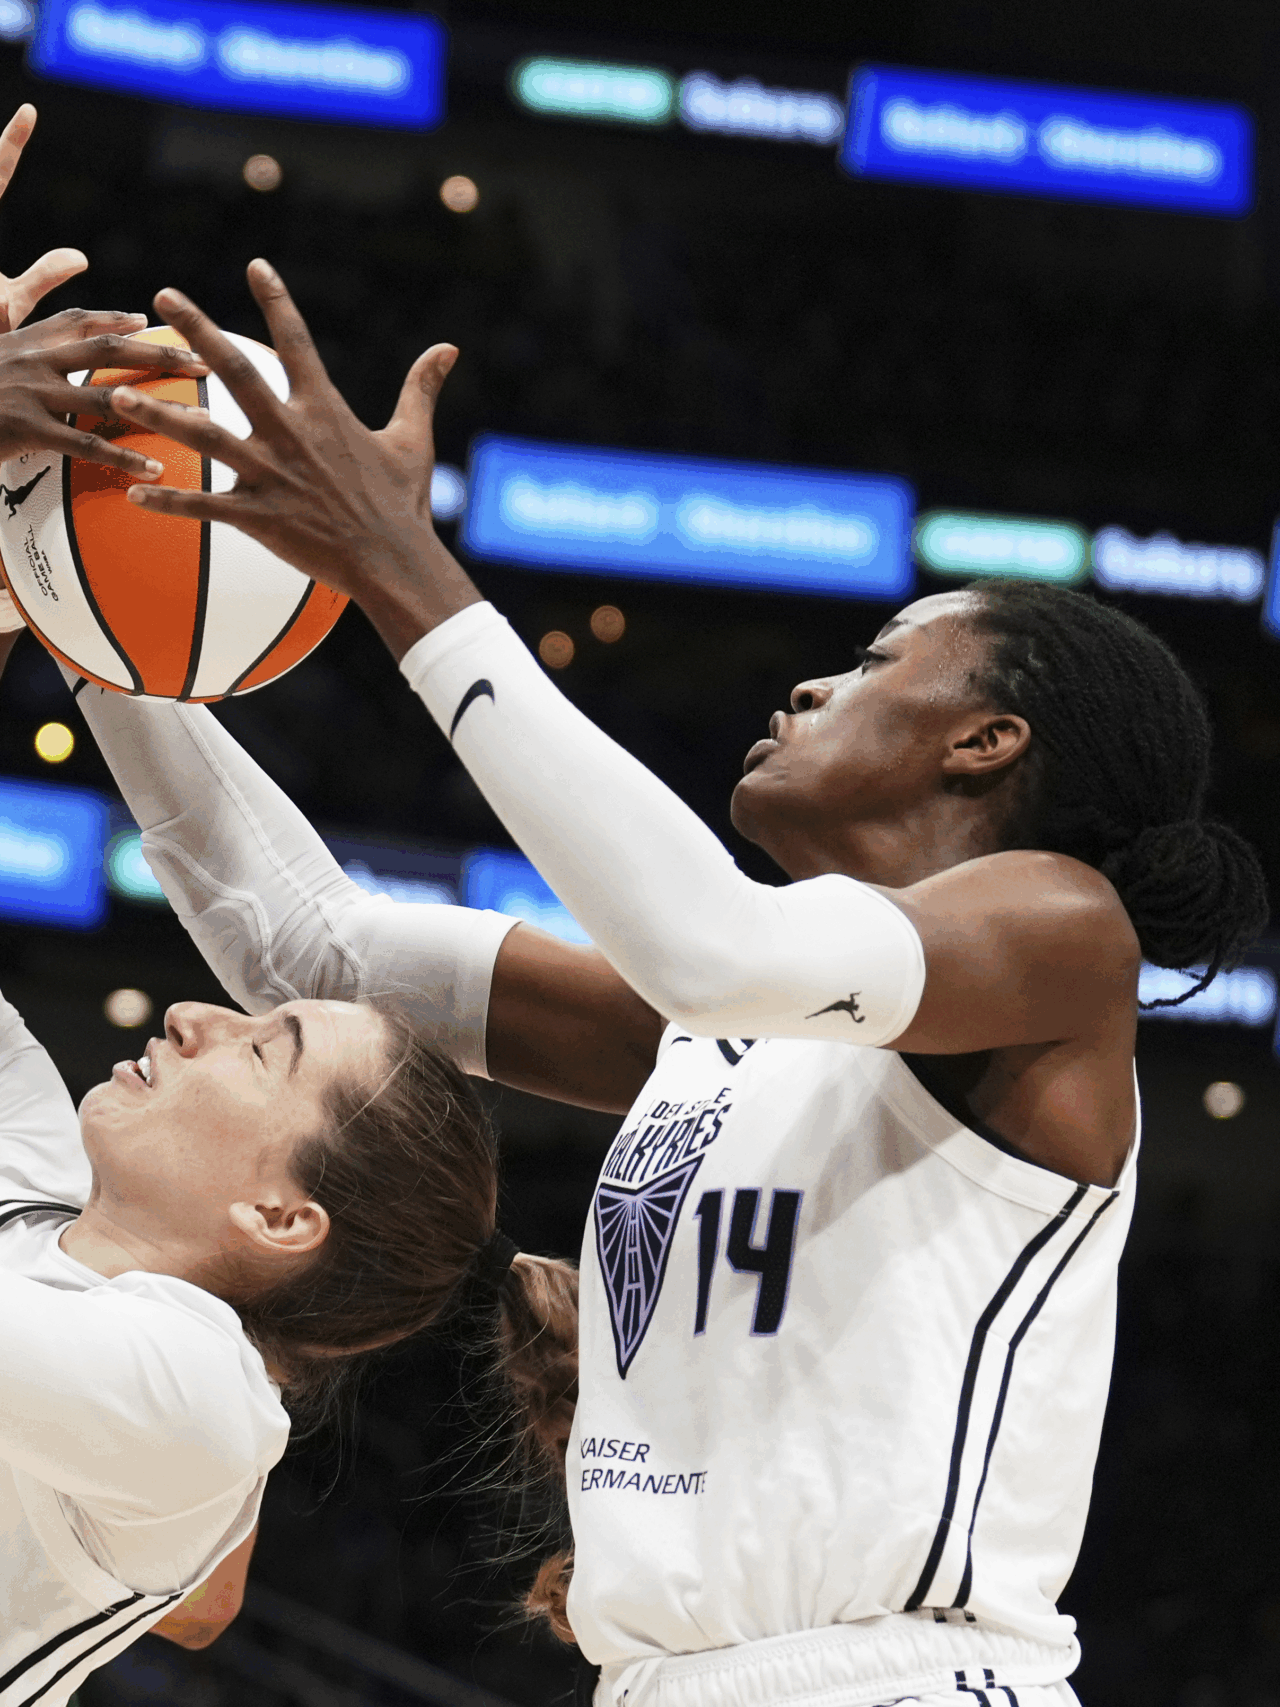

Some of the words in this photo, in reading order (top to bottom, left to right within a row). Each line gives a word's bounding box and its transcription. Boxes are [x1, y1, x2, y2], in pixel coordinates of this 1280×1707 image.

[28, 524, 40, 560] BALL
[24, 537, 48, 596] OFFICIAL
[38, 562, 59, 601] GAME
[691, 1187, 805, 1337] 14
[581, 1469, 708, 1495] ERMANENTE
